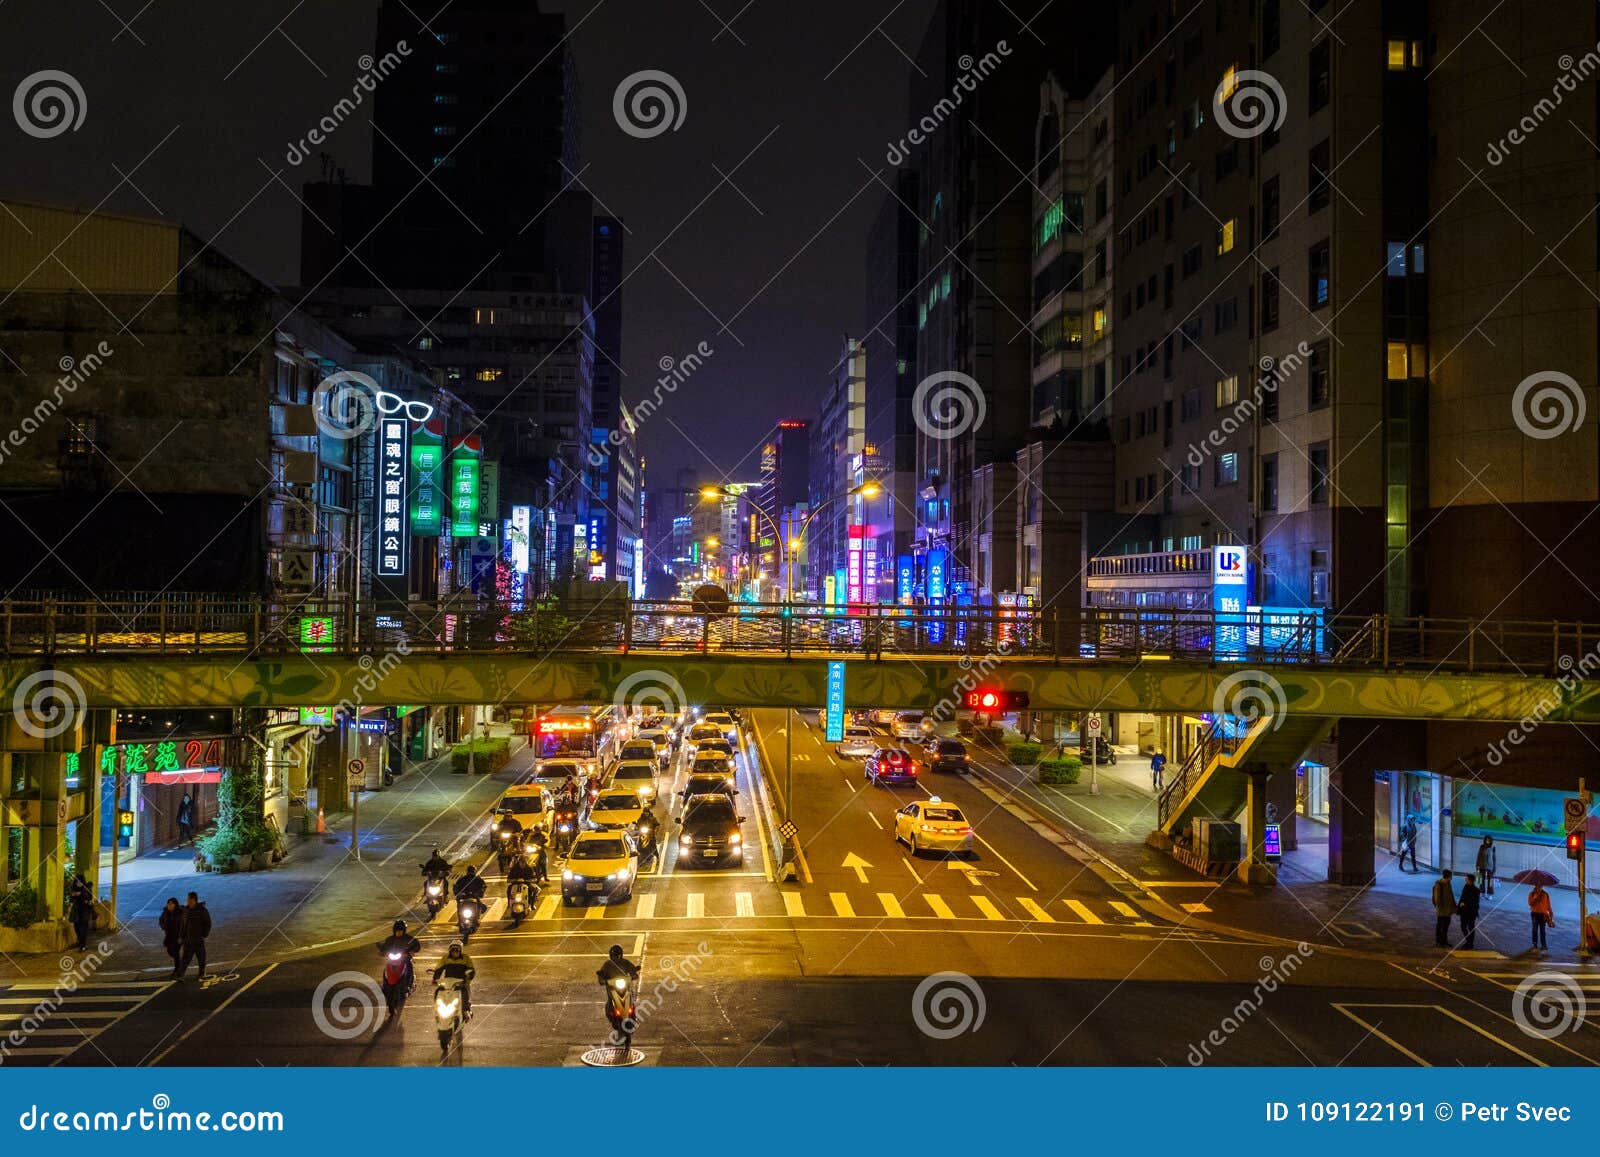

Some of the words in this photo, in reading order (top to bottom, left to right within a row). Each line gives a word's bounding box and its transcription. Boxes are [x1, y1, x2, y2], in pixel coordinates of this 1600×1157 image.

[417, 453, 433, 521] 信義房屋
[458, 466, 472, 523] 信義房屋
[831, 670, 841, 712] 南京西路
